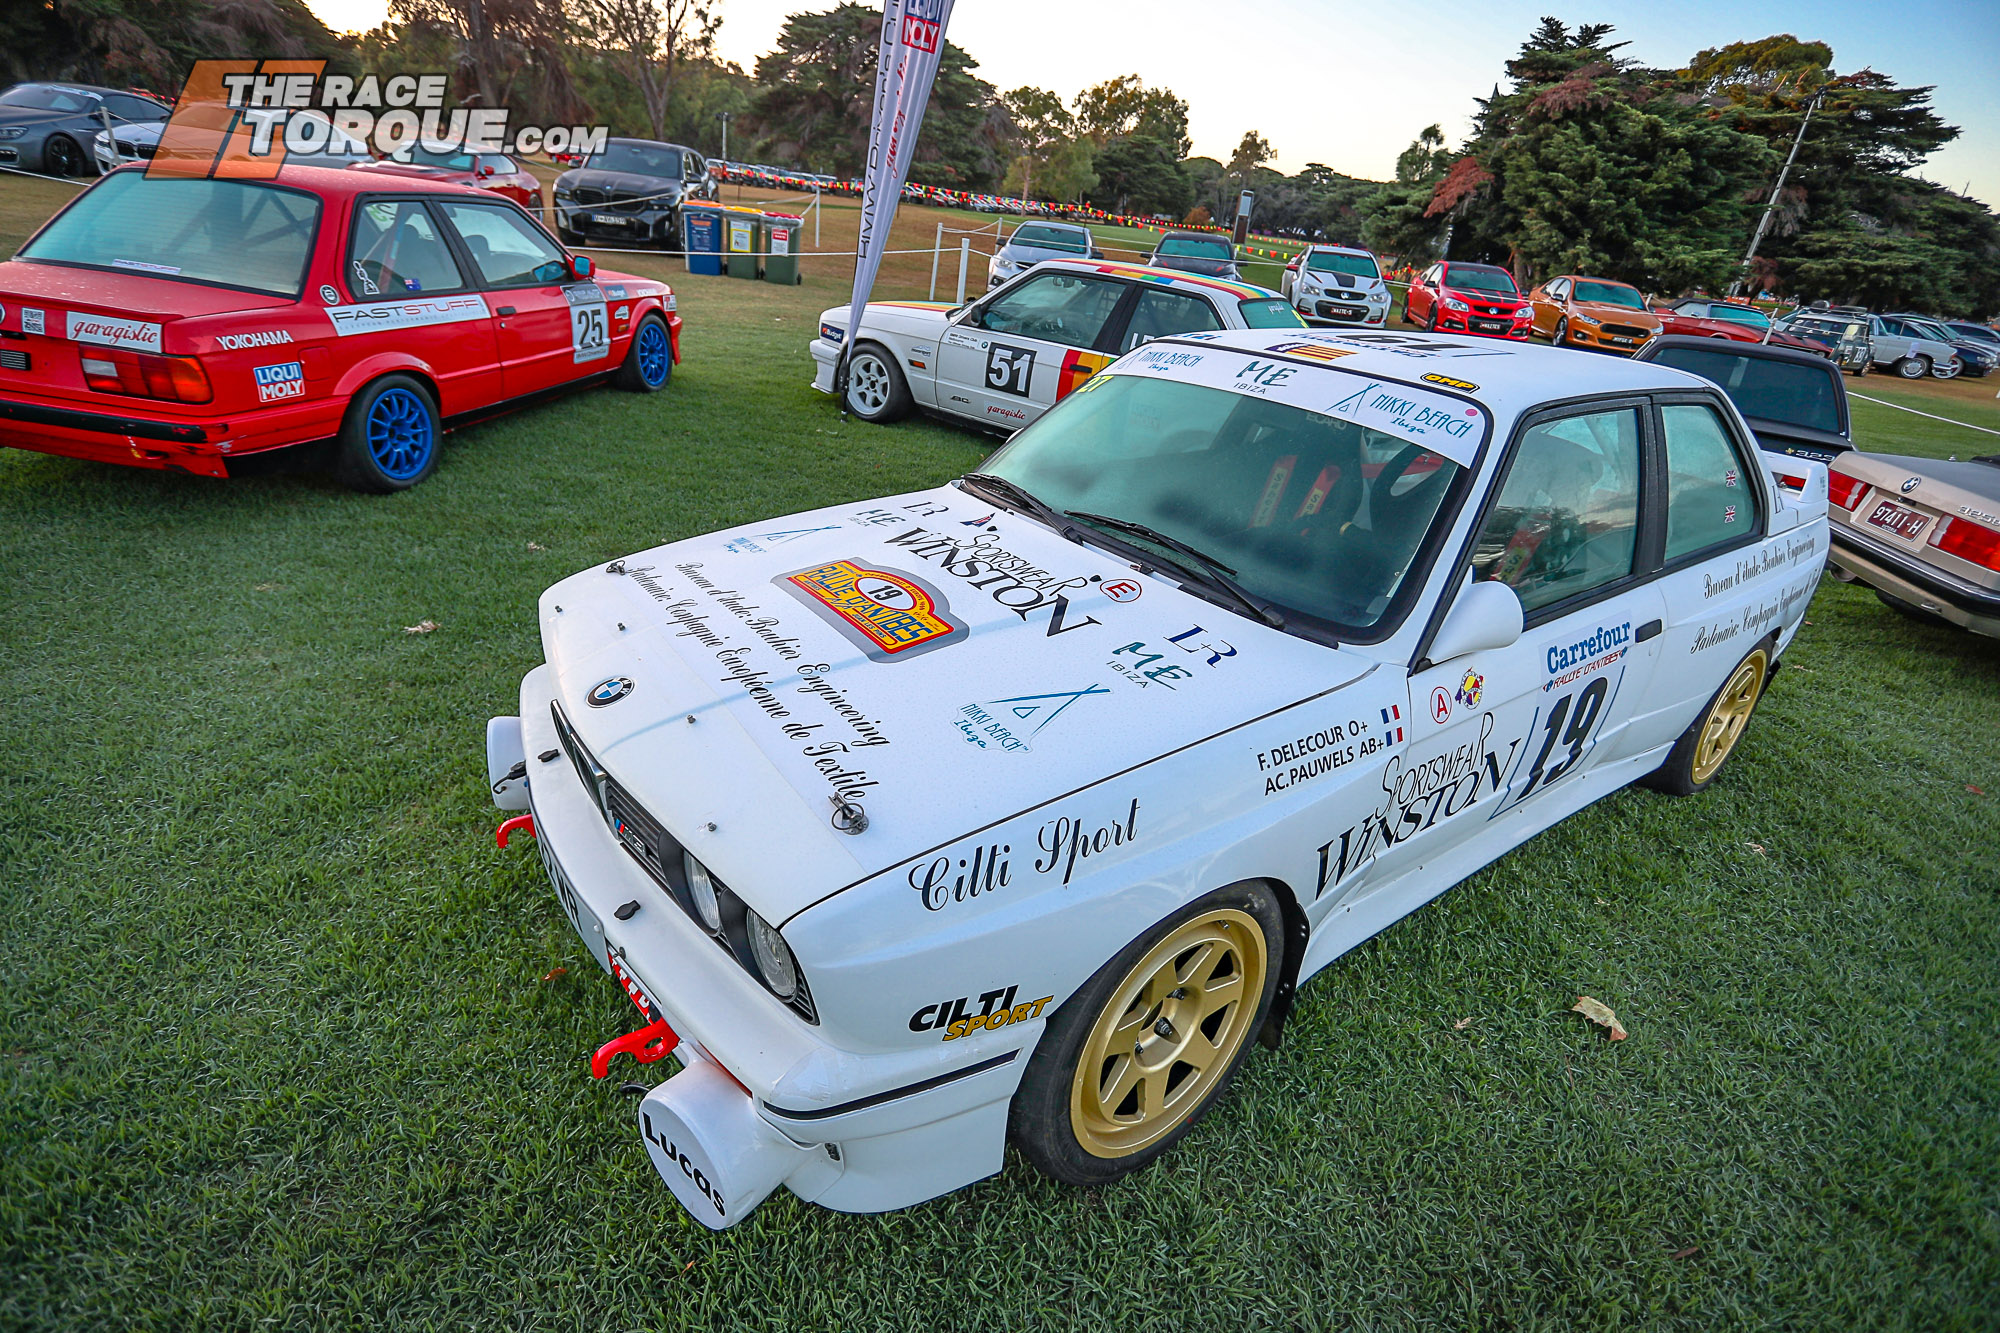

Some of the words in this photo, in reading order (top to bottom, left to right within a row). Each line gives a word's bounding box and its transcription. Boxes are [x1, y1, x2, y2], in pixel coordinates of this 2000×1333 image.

[332, 299, 479, 323] FASTSTUFF
[72, 321, 158, 345] garagistic
[216, 330, 294, 351] YOKOHAMA
[577, 308, 604, 349] 25
[257, 363, 300, 384] LIQUI
[988, 347, 1032, 392] 51
[1164, 352, 1204, 368] BEACH
[1235, 360, 1298, 387] ME
[260, 379, 302, 402] MOLY
[1233, 381, 1267, 395] IBIZA
[1424, 373, 1474, 391] OMP
[987, 405, 1026, 420] garagistic
[1369, 393, 1412, 416] NIKKI
[1414, 403, 1474, 439] BEACH
[1390, 417, 1426, 436] Ibiza
[902, 501, 950, 517] LR
[954, 532, 1090, 597] SPORTSWEAR
[867, 584, 904, 602] 19
[884, 526, 1103, 638] WINSTON
[1107, 581, 1139, 600] E
[1703, 573, 1733, 600] Bureau
[804, 565, 855, 599] RALLYE
[847, 594, 934, 643] D'ANTIBES
[852, 613, 865, 624] JUAN
[864, 622, 875, 630] LES
[874, 627, 887, 639] PINS
[675, 562, 716, 592] Bureau
[797, 663, 891, 747] Engineering
[1163, 622, 1239, 669] LR
[1546, 621, 1631, 675] Carrefour
[1105, 659, 1151, 690] IBIZA
[1111, 641, 1194, 692] ME
[1552, 667, 1584, 690] RALLYE
[716, 646, 791, 720] Européenne
[959, 703, 993, 736] NIKKI
[1434, 693, 1450, 719] A
[781, 722, 825, 741] de
[952, 718, 988, 750] Ibiza
[1270, 724, 1346, 768] DELECOUR
[1348, 719, 1369, 737] O+
[1359, 736, 1384, 759] AB+
[1515, 676, 1609, 802] 19
[802, 740, 880, 801] Textile
[1375, 711, 1494, 817] SPORTSWEAR
[1315, 737, 1522, 901] WINSTON
[907, 844, 1012, 912] Cilti
[1034, 797, 1140, 888] Sport
[907, 984, 1020, 1034] CILTI
[942, 994, 1054, 1042] SPORT
[642, 1110, 728, 1218] Lucas
